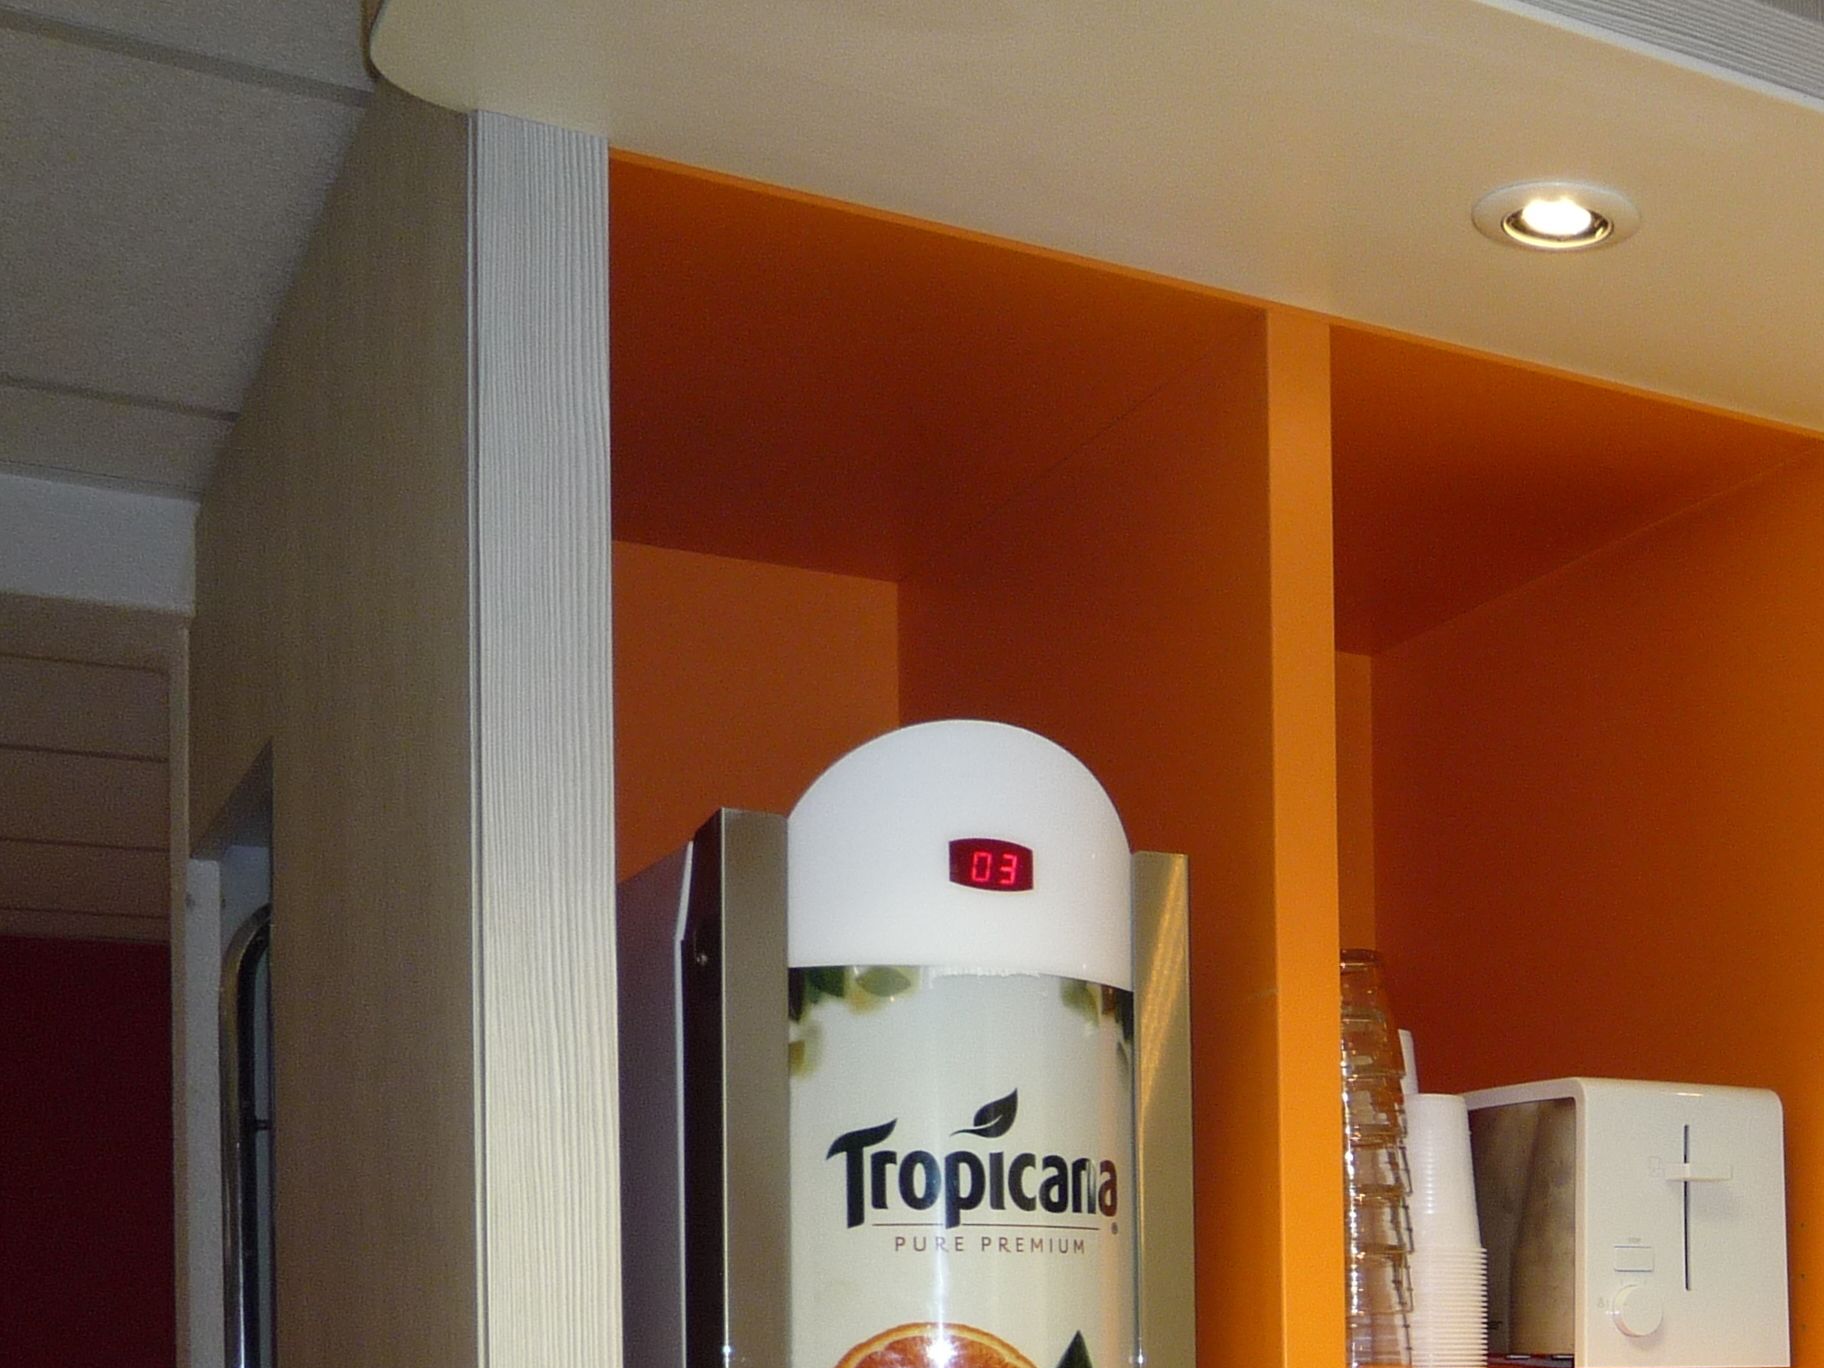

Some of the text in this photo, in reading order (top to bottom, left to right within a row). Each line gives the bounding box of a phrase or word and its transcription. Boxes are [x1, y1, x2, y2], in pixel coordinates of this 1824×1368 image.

[971, 850, 1018, 885] 03
[826, 1117, 1118, 1229] Tropicana
[894, 1235, 1085, 1254] PURE PREMIUM
